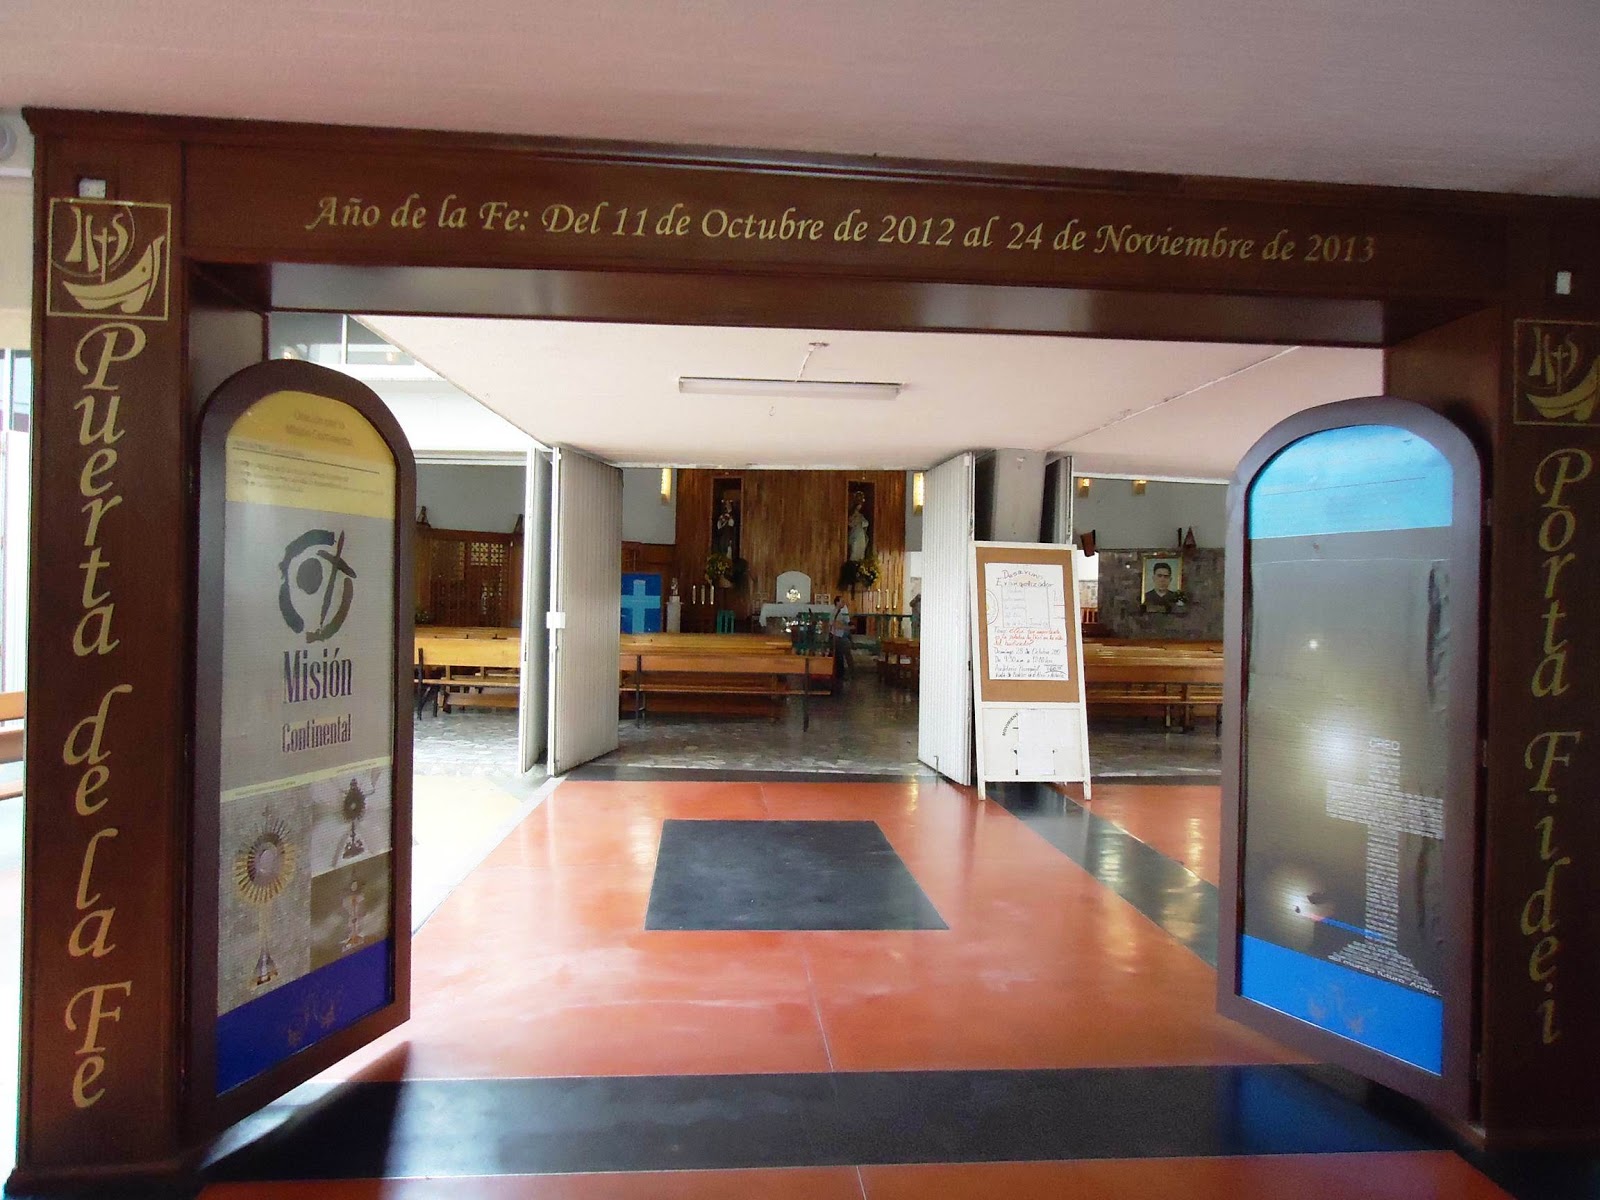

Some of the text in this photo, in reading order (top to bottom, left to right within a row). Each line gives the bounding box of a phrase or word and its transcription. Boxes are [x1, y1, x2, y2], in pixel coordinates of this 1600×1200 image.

[305, 193, 1377, 264] Año de la Fe: Del 11 de Octubre de 2012 al 24 de Noviembre de 2013
[1531, 447, 1592, 698] Porta
[283, 647, 353, 704] Misión
[63, 322, 147, 1108] Puerta de la Fe
[282, 714, 352, 753] Continental
